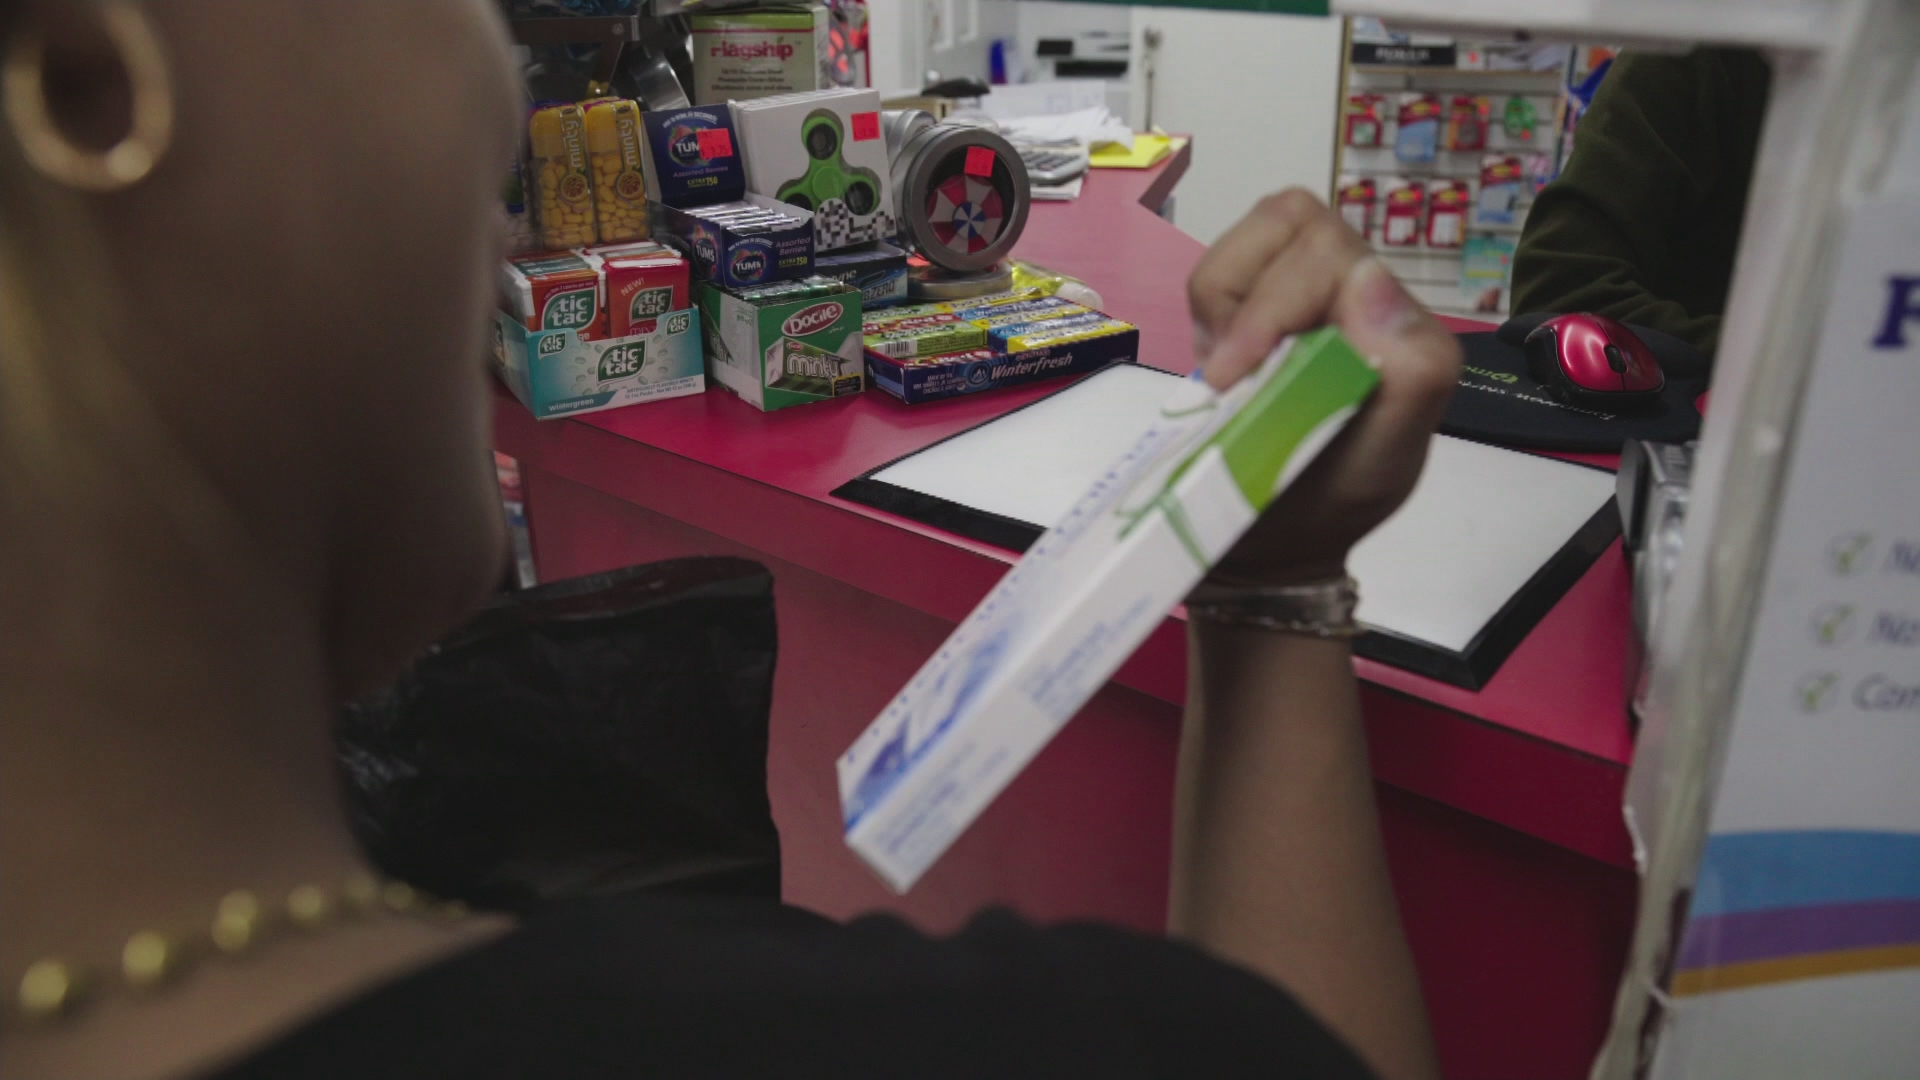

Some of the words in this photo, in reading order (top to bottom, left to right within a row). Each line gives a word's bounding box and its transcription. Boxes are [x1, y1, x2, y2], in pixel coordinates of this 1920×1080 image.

[675, 141, 700, 154] TUM
[775, 236, 811, 248] Assorted
[696, 245, 715, 262] TUMS
[779, 246, 807, 256] Berries
[621, 277, 645, 296] NEW!
[558, 295, 588, 312] tic
[642, 289, 667, 305] tic
[638, 302, 665, 315] tac
[552, 311, 588, 326] tac
[612, 345, 638, 362] tic
[605, 360, 638, 376] tac
[991, 352, 1073, 380] Winterfresh
[549, 399, 594, 412] wintergreen
